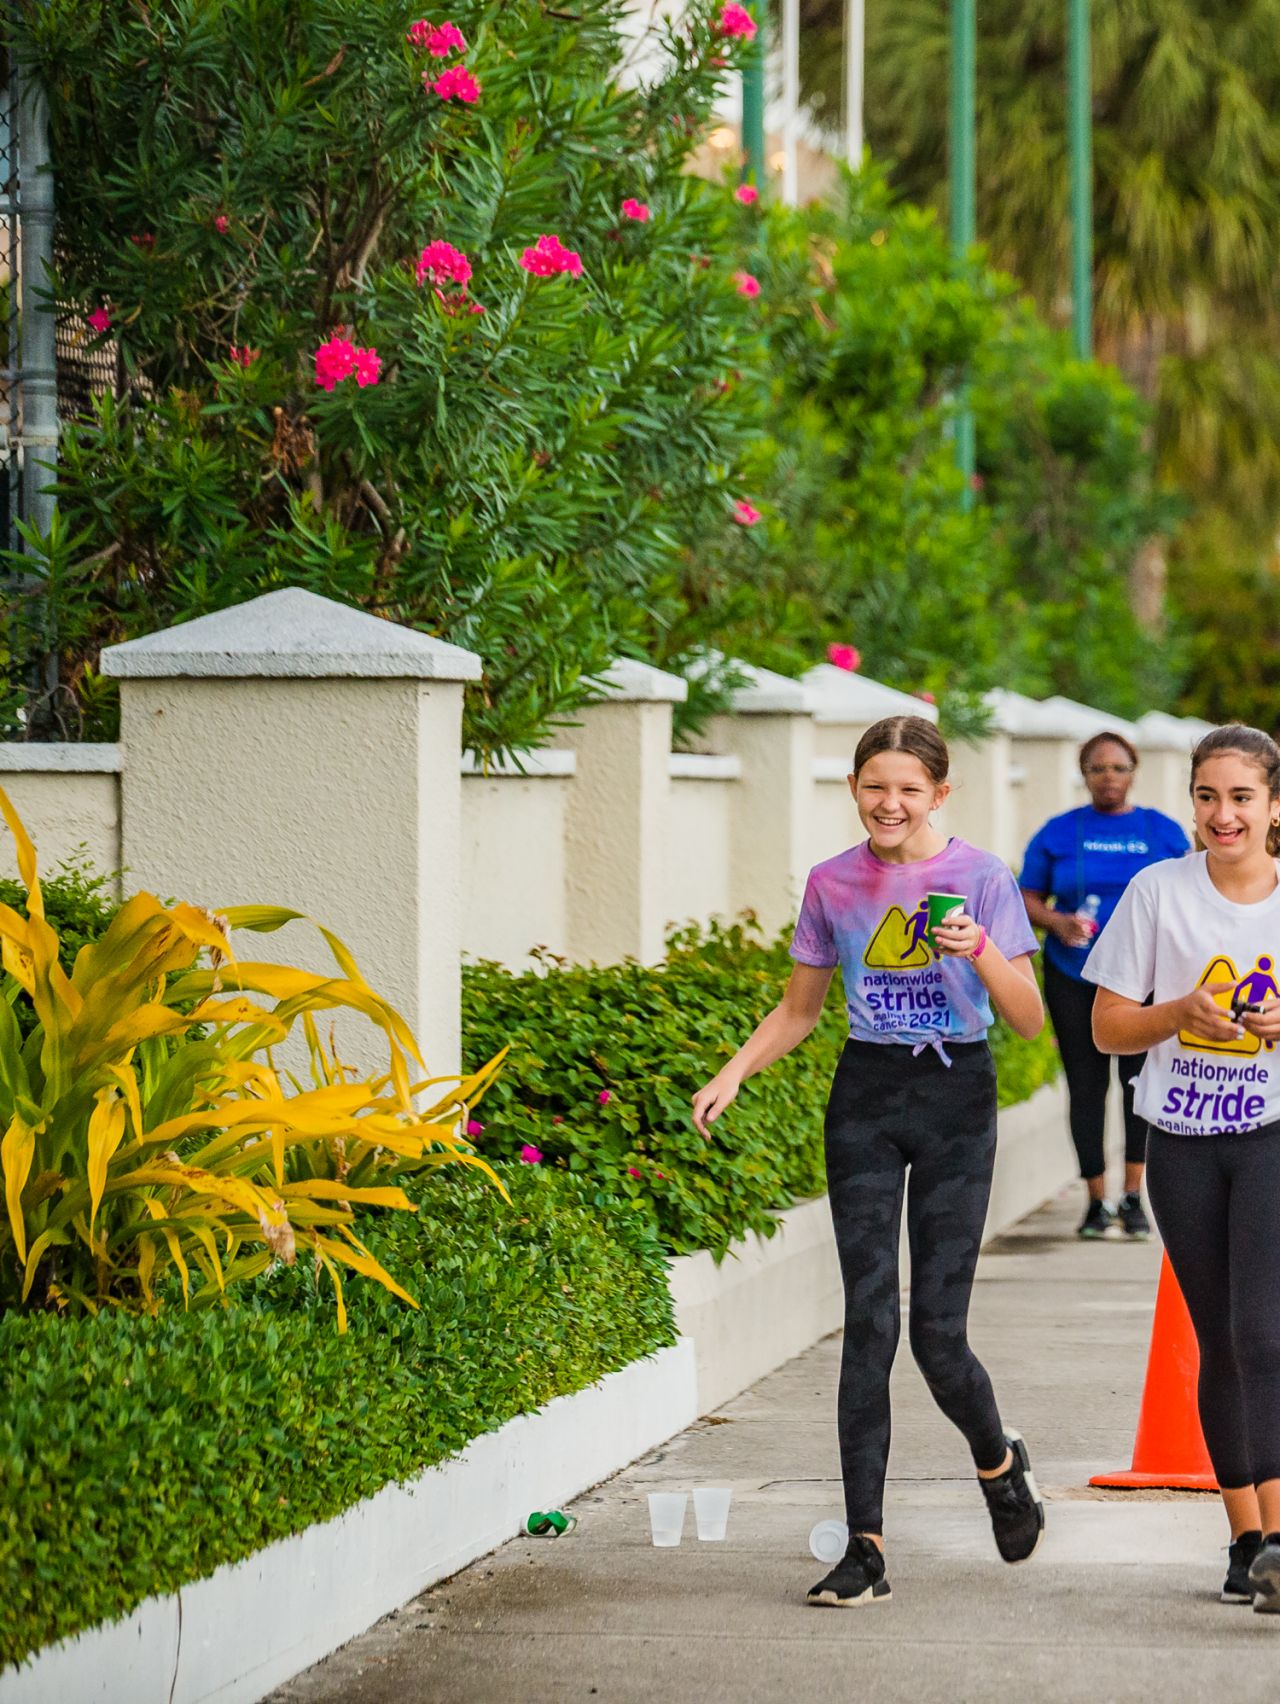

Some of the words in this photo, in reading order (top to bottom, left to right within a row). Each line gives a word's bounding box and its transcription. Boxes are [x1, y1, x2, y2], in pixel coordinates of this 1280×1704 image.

[863, 971, 943, 986] nationwide
[866, 986, 947, 1011] stride
[909, 1009, 950, 1028] 2021
[1171, 1057, 1269, 1084] nationwide
[1162, 1081, 1265, 1122] stride
